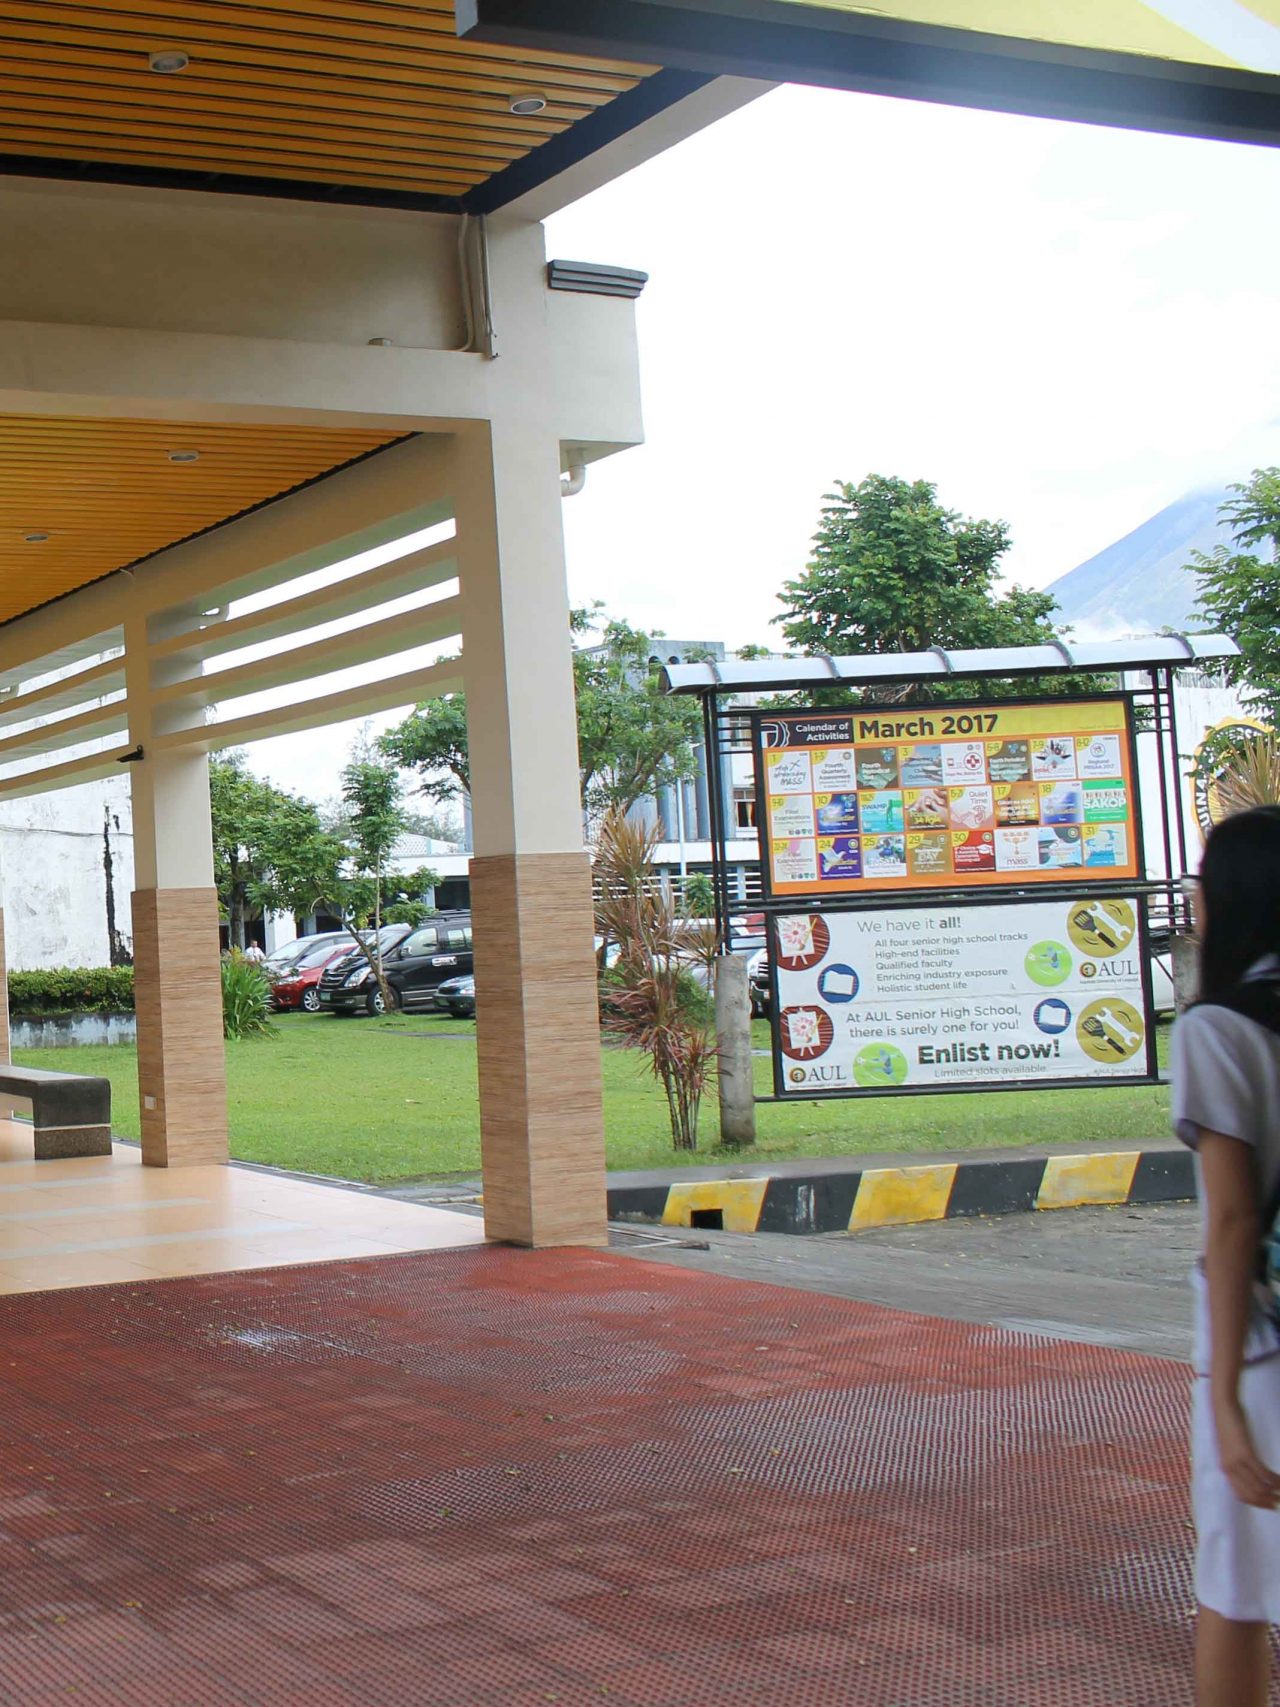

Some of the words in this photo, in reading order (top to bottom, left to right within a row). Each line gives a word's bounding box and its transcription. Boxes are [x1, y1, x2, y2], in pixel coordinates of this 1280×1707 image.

[796, 724, 836, 733] Calendar
[839, 722, 849, 730] of
[860, 716, 934, 739] March
[941, 714, 998, 735] 2017
[806, 732, 850, 741] Activities
[968, 790, 988, 798] Quiet
[997, 786, 1006, 796] 17
[1041, 784, 1052, 793] 18
[1083, 798, 1126, 809] SAKOP
[953, 832, 967, 842] 30
[1085, 826, 1095, 836] 31
[819, 839, 832, 849] 24
[863, 837, 876, 847] 25
[908, 835, 920, 845] 29
[856, 920, 882, 933] We
[886, 919, 921, 932] have
[925, 917, 935, 930] it
[939, 916, 962, 929] all!
[874, 939, 887, 948] All
[889, 938, 909, 947] four
[911, 938, 940, 946] senior
[943, 936, 964, 946] high
[966, 934, 998, 943] school
[999, 932, 1029, 941] tracks
[875, 950, 919, 960] High-end
[921, 948, 960, 957] facilities
[875, 960, 919, 971] Qualified
[921, 959, 953, 969] faculty
[1098, 959, 1138, 977] AUL
[876, 971, 921, 982] Enriching
[923, 970, 962, 981] industry
[964, 968, 1008, 978] exposure
[877, 983, 912, 993] Holistic
[914, 982, 951, 991] student
[953, 981, 967, 990] life
[846, 1012, 860, 1023] At
[864, 1011, 892, 1022] AUL
[895, 1009, 937, 1021] Senior
[940, 1006, 970, 1019] High
[974, 1004, 1021, 1016] School,
[850, 1026, 883, 1038] there
[887, 1025, 897, 1036] is
[900, 1023, 939, 1037] surely
[942, 1023, 966, 1034] one
[970, 1020, 989, 1031] for
[992, 1019, 1019, 1032] you!
[918, 1042, 990, 1065] Enlist
[997, 1039, 1060, 1062] now!
[808, 1065, 847, 1082] AUL
[934, 1067, 974, 1078] Limited
[976, 1065, 999, 1076] slots
